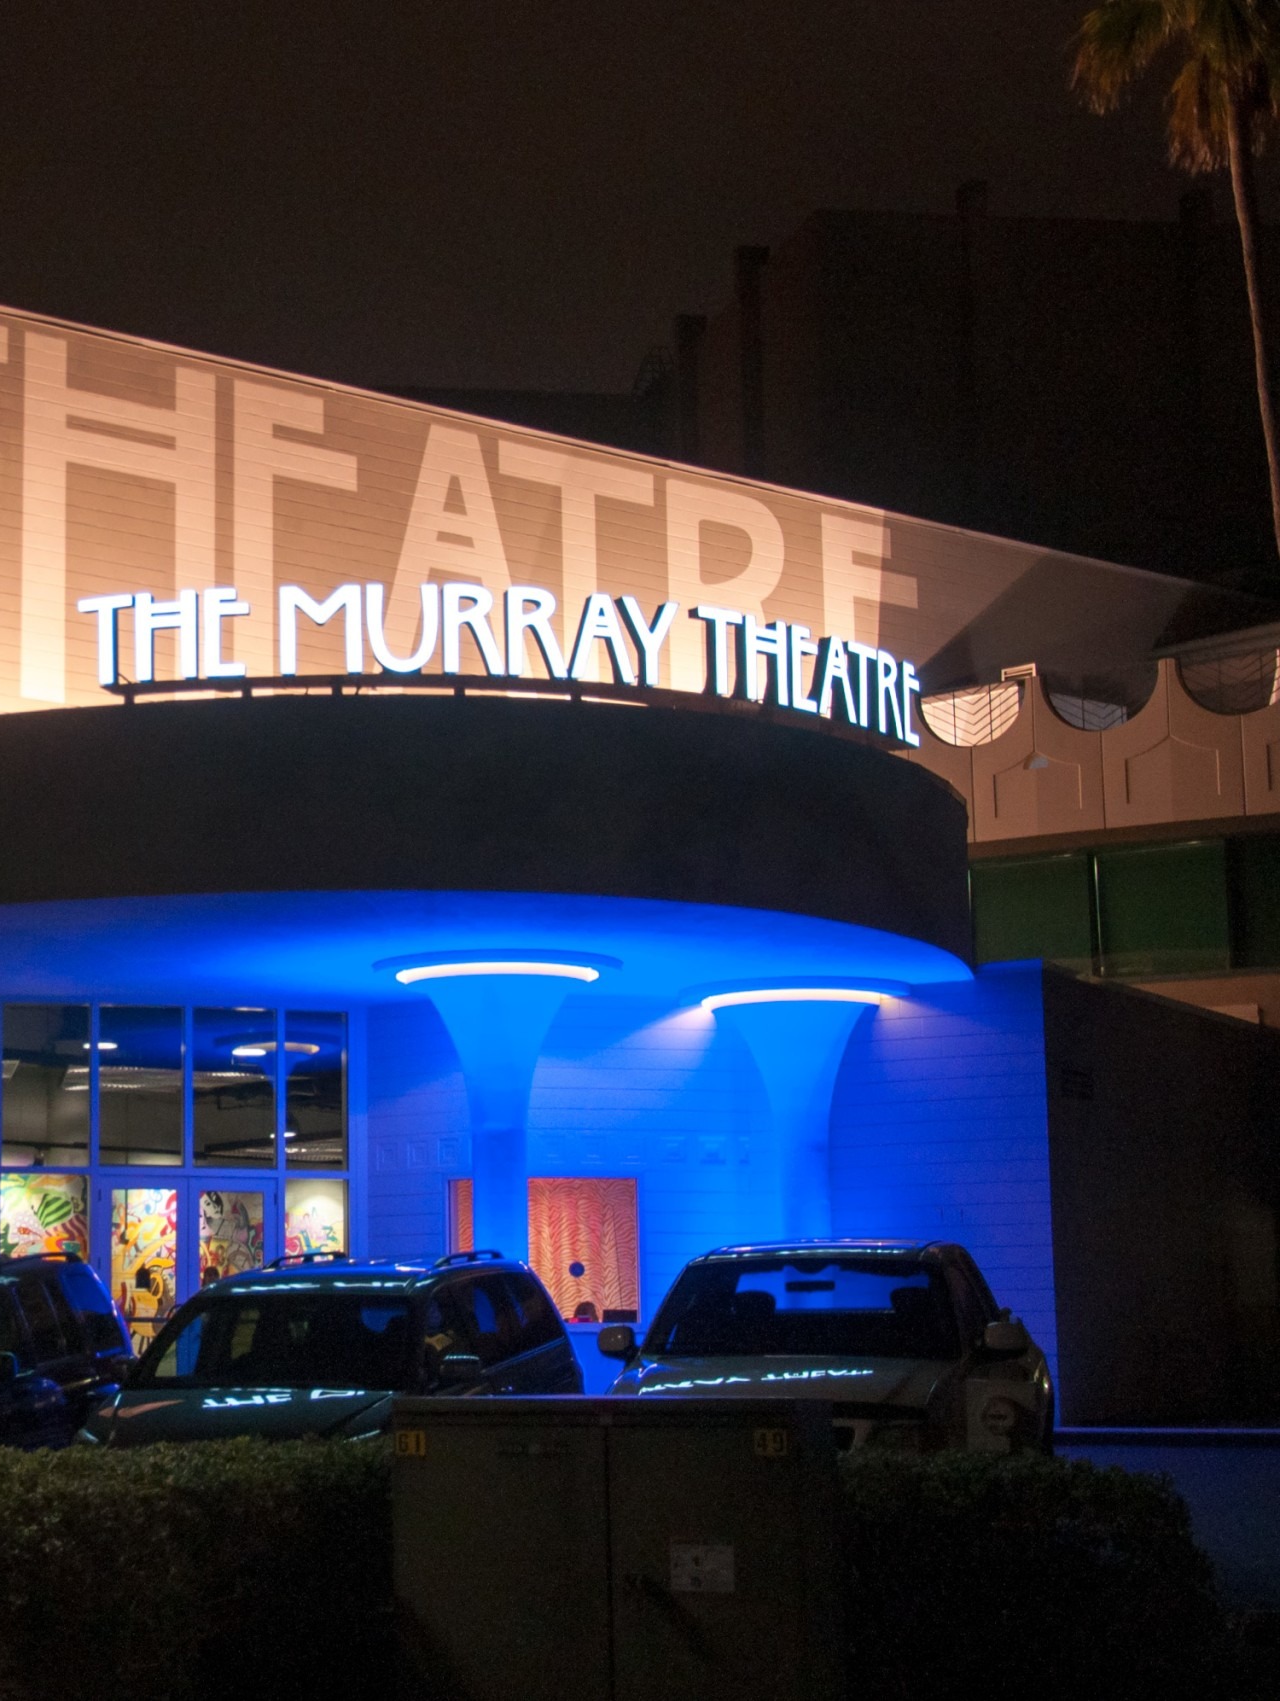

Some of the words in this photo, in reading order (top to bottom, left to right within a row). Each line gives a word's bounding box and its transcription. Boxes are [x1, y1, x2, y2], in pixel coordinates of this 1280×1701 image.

[77, 588, 251, 687] THE
[278, 583, 681, 688] MURRAY
[689, 605, 921, 748] THEATRE
[398, 1433, 421, 1453] 61
